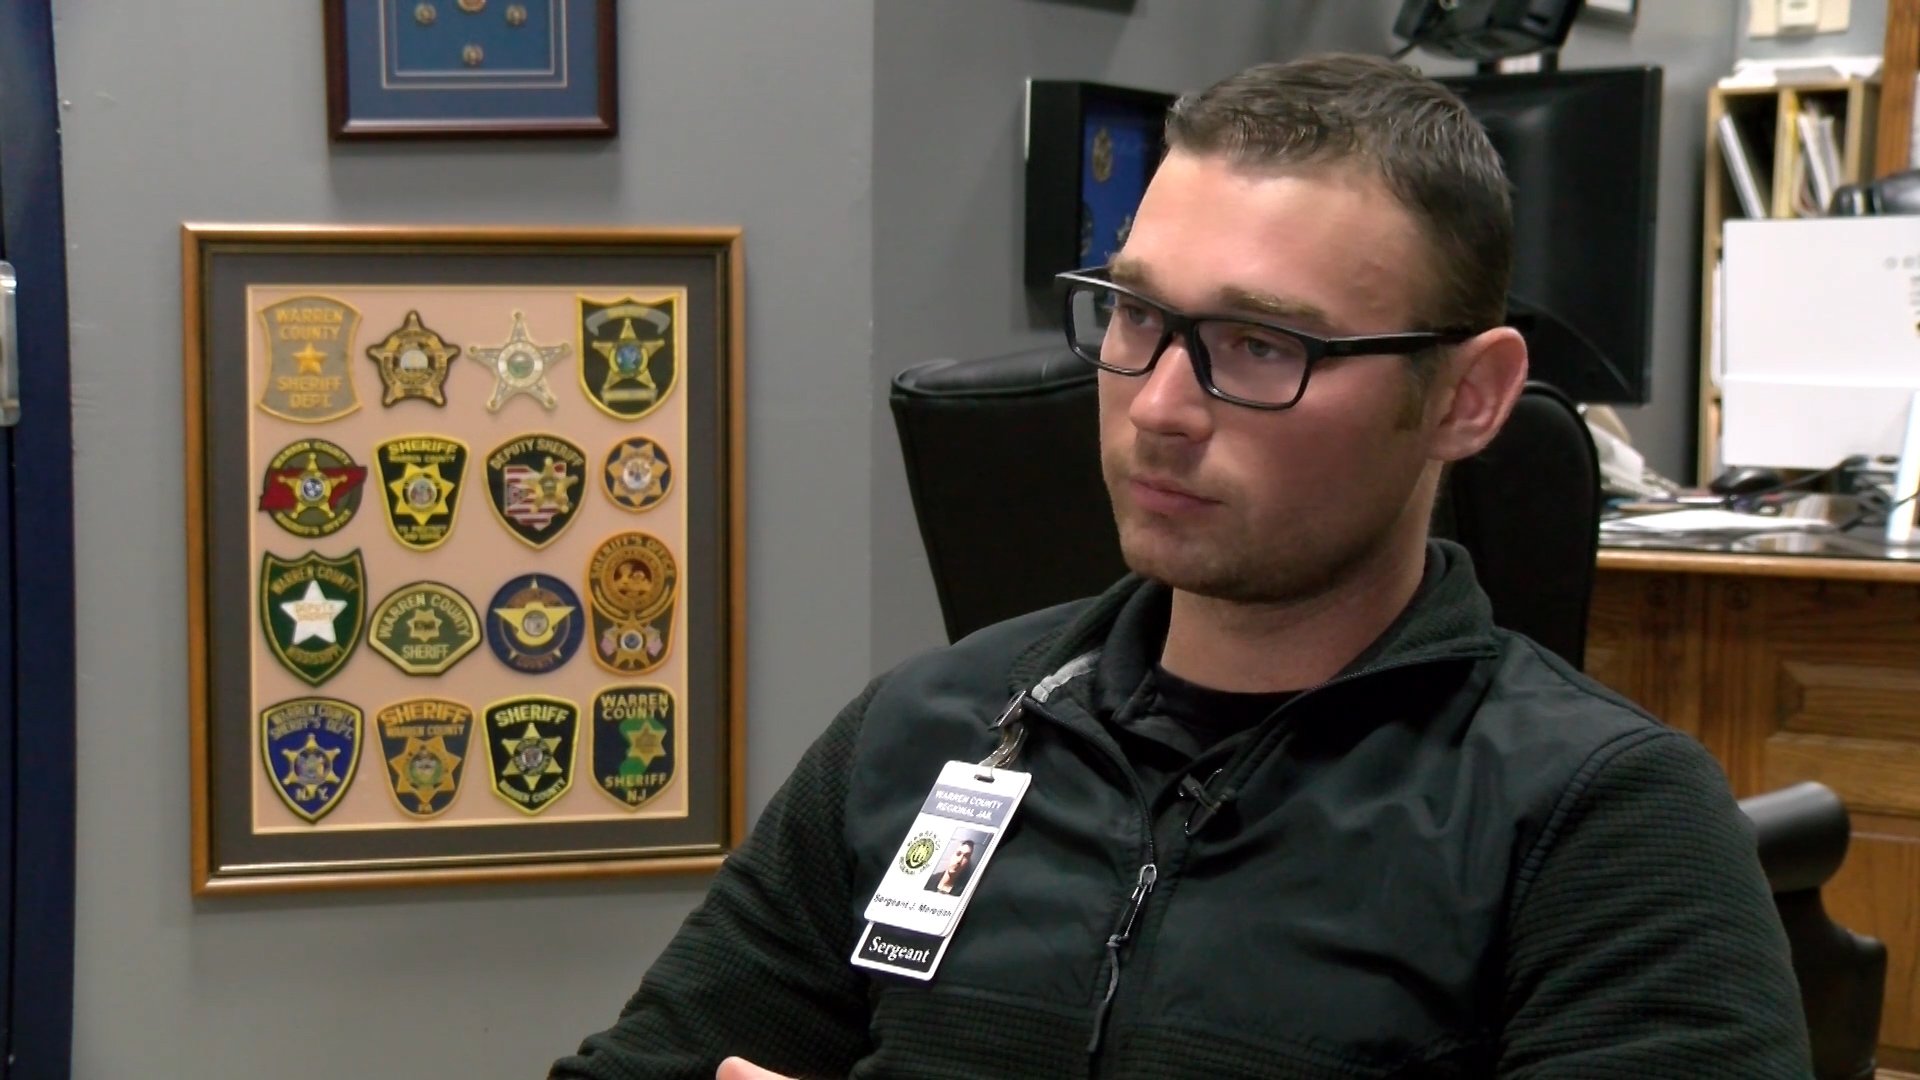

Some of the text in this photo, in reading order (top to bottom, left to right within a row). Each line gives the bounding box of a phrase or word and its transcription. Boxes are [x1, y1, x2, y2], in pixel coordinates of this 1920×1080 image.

[276, 308, 343, 323] WARREN
[280, 325, 340, 339] COUNTY
[277, 377, 341, 391] SHERIFF
[388, 440, 458, 455] SHERIFF
[490, 439, 585, 470] DEPUTY SHERIFF
[271, 565, 359, 595] WARREN COUNTY
[379, 592, 426, 638] WARREN
[430, 593, 472, 637] COUNTY
[402, 644, 450, 660] SHERIFF
[602, 693, 669, 707] WARREN
[380, 701, 466, 726] SHERIFF
[495, 704, 569, 727] SHERIFF
[602, 705, 669, 719] COUNTY
[427, 725, 465, 736] COUNTY
[604, 773, 666, 788] SHERIFF
[532, 778, 566, 803] COUNTY
[627, 789, 647, 802] NJ
[935, 790, 1004, 810] WARREN COUNTY
[936, 801, 993, 821] REGIONAL JAIL
[873, 893, 910, 909] Sergeant
[868, 936, 930, 963] Sergeant
